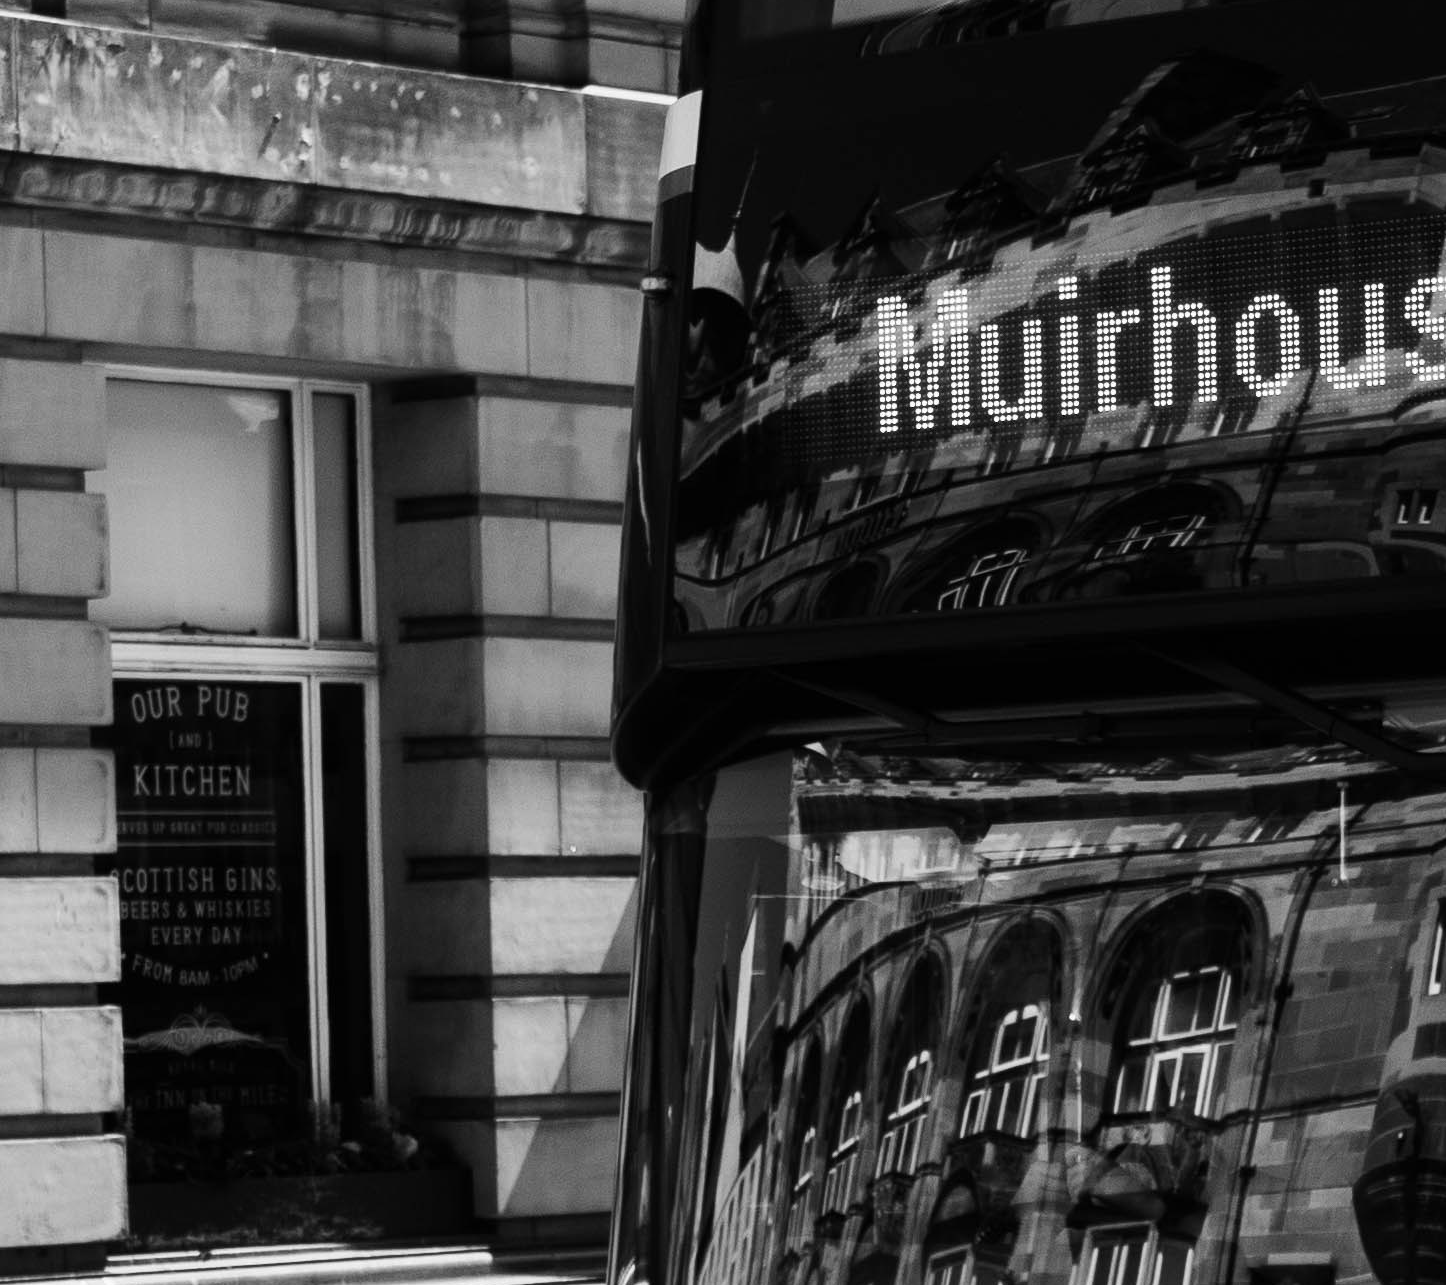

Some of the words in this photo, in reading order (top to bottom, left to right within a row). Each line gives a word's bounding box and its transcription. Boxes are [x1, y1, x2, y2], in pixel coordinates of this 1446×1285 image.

[131, 686, 183, 723] OUR
[196, 684, 250, 723] PUB
[132, 764, 252, 797] KITCHEN
[121, 899, 171, 920] BEERS
[176, 903, 187, 919] &
[194, 898, 272, 919] WHISKIES
[151, 926, 203, 946] EVERY
[211, 925, 243, 946] DAY
[131, 954, 173, 984] FROM
